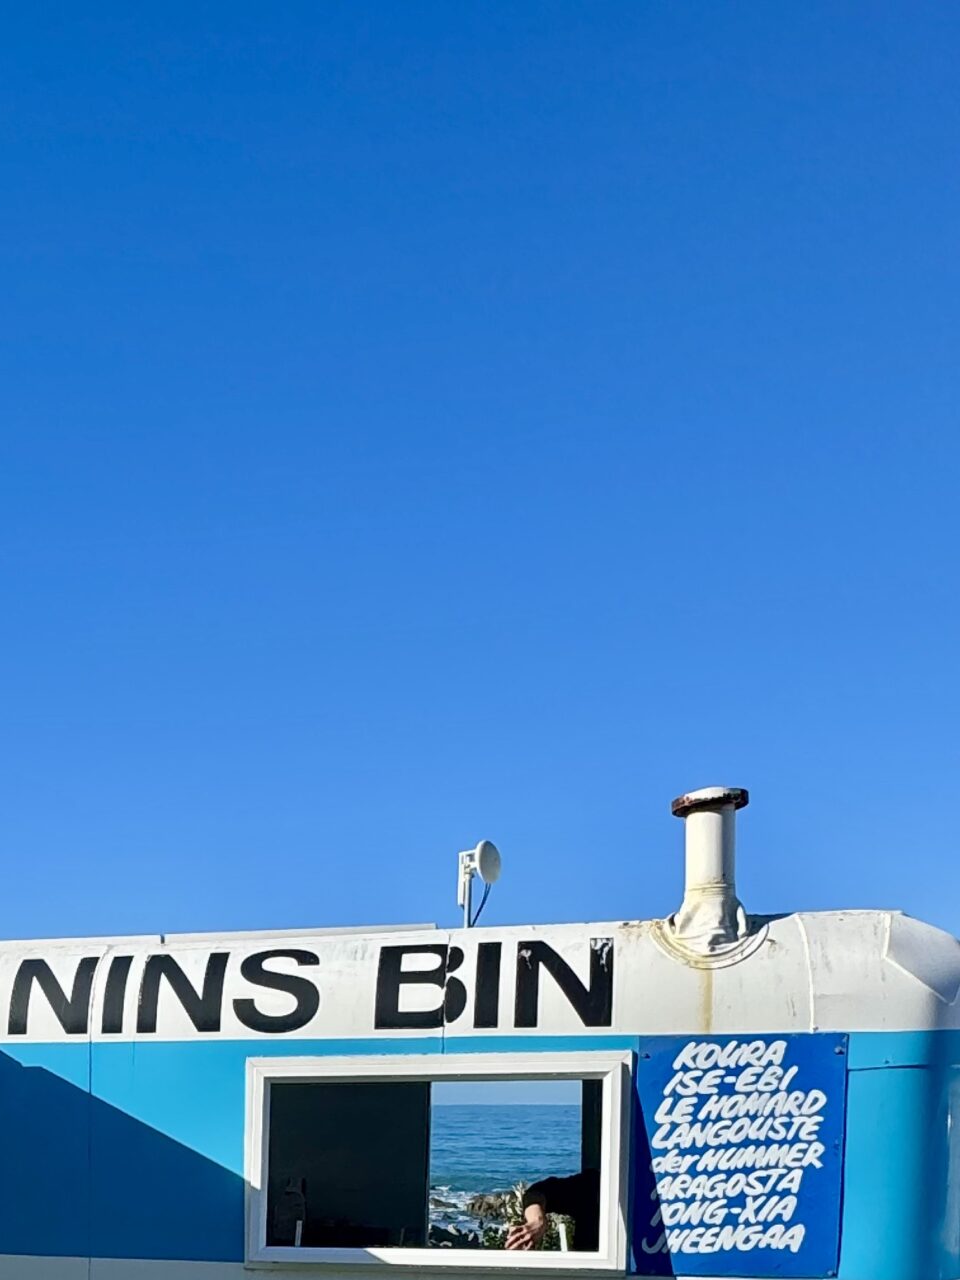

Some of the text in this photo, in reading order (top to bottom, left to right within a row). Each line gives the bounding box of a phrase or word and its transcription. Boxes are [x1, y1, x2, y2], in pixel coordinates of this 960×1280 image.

[7, 937, 615, 1034] NINS BIN
[672, 1040, 787, 1070] KOURA
[663, 1065, 798, 1096] ISE-EBI
[654, 1090, 827, 1124] LE HOMARD
[651, 1115, 824, 1149] LANGOUSTE
[650, 1141, 826, 1174] der HUMMER
[651, 1168, 803, 1201] ARAGOSTA
